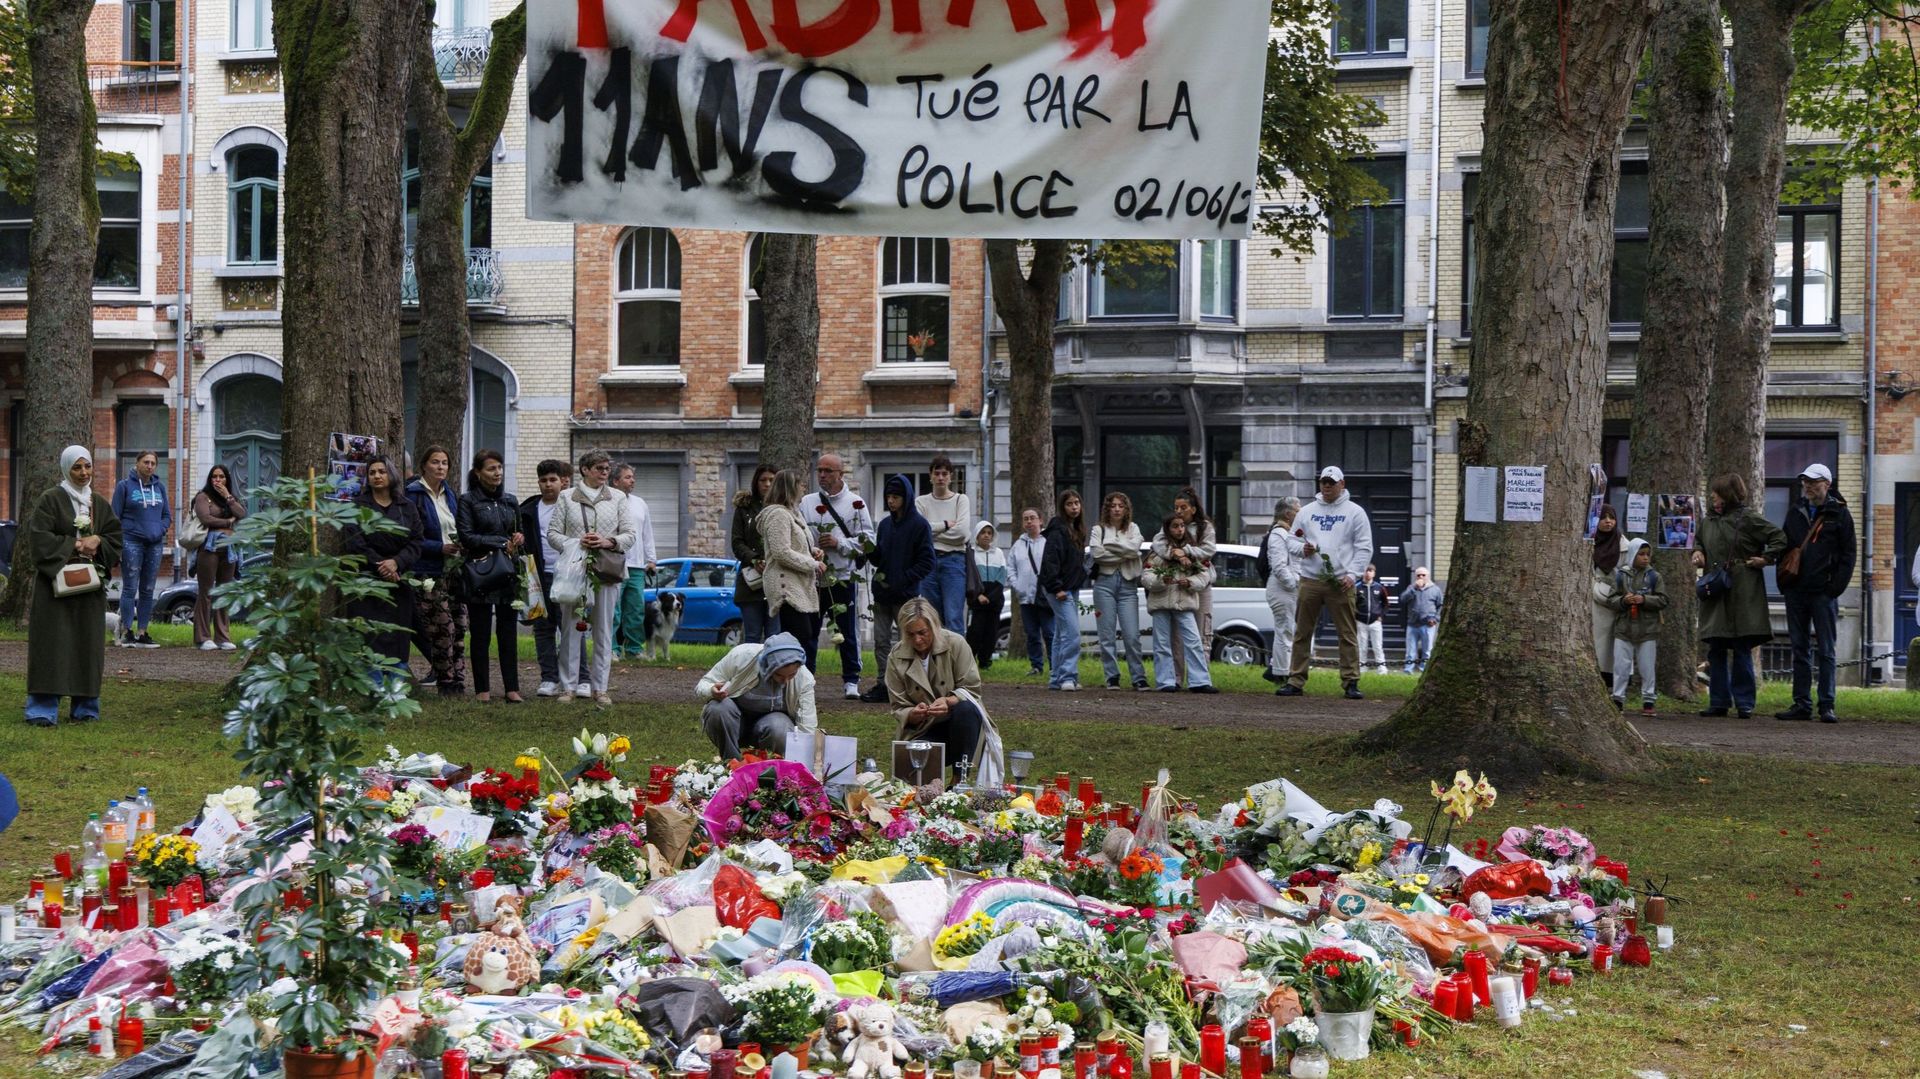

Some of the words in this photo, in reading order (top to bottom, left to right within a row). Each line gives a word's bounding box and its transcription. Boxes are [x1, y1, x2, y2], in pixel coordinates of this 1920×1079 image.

[1023, 73, 1112, 129] PAR
[1138, 80, 1199, 142] LA
[897, 144, 1078, 219] POLICE
